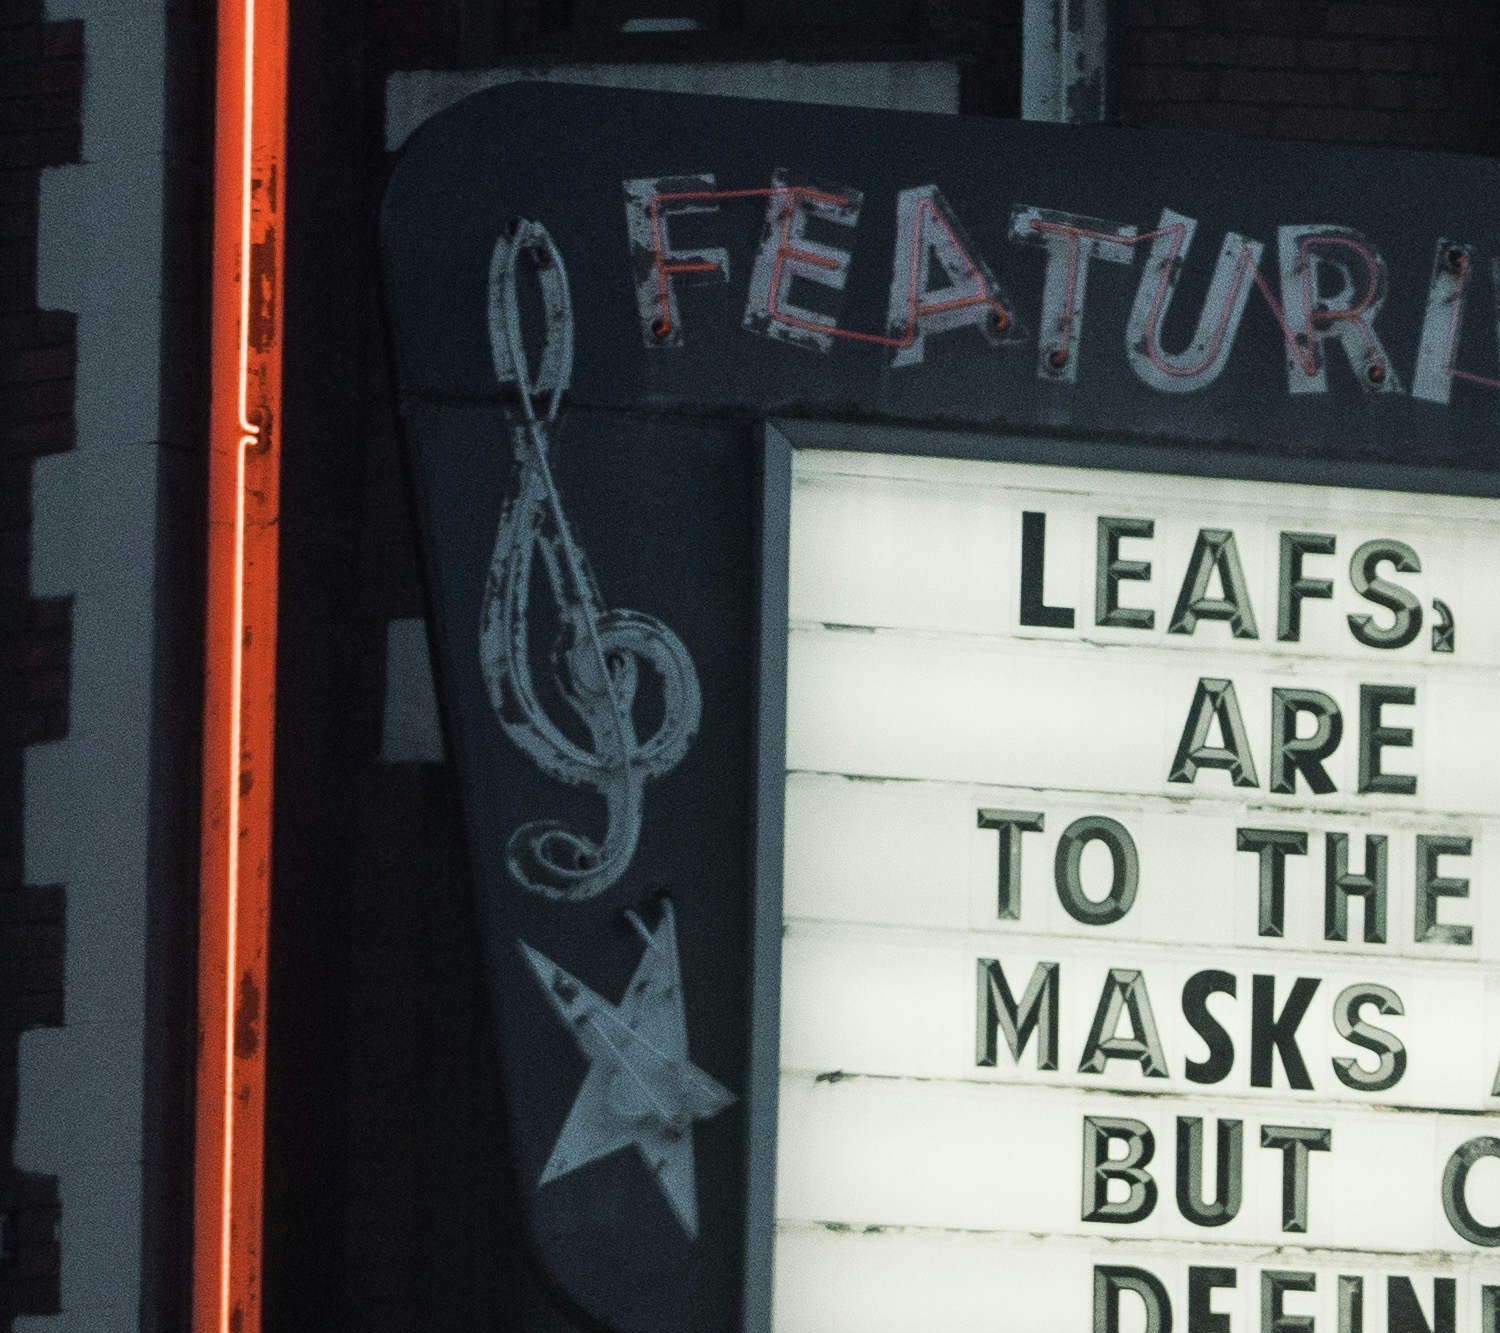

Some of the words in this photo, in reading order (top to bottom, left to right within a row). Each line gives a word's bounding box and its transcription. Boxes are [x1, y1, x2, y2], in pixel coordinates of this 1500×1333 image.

[1018, 510, 1457, 654] LEAFS,
[1166, 676, 1419, 797] ARE
[975, 807, 1141, 926] TO
[1235, 827, 1475, 946] THE
[974, 957, 1408, 1093] MASKS
[1080, 1114, 1332, 1234] BUT
